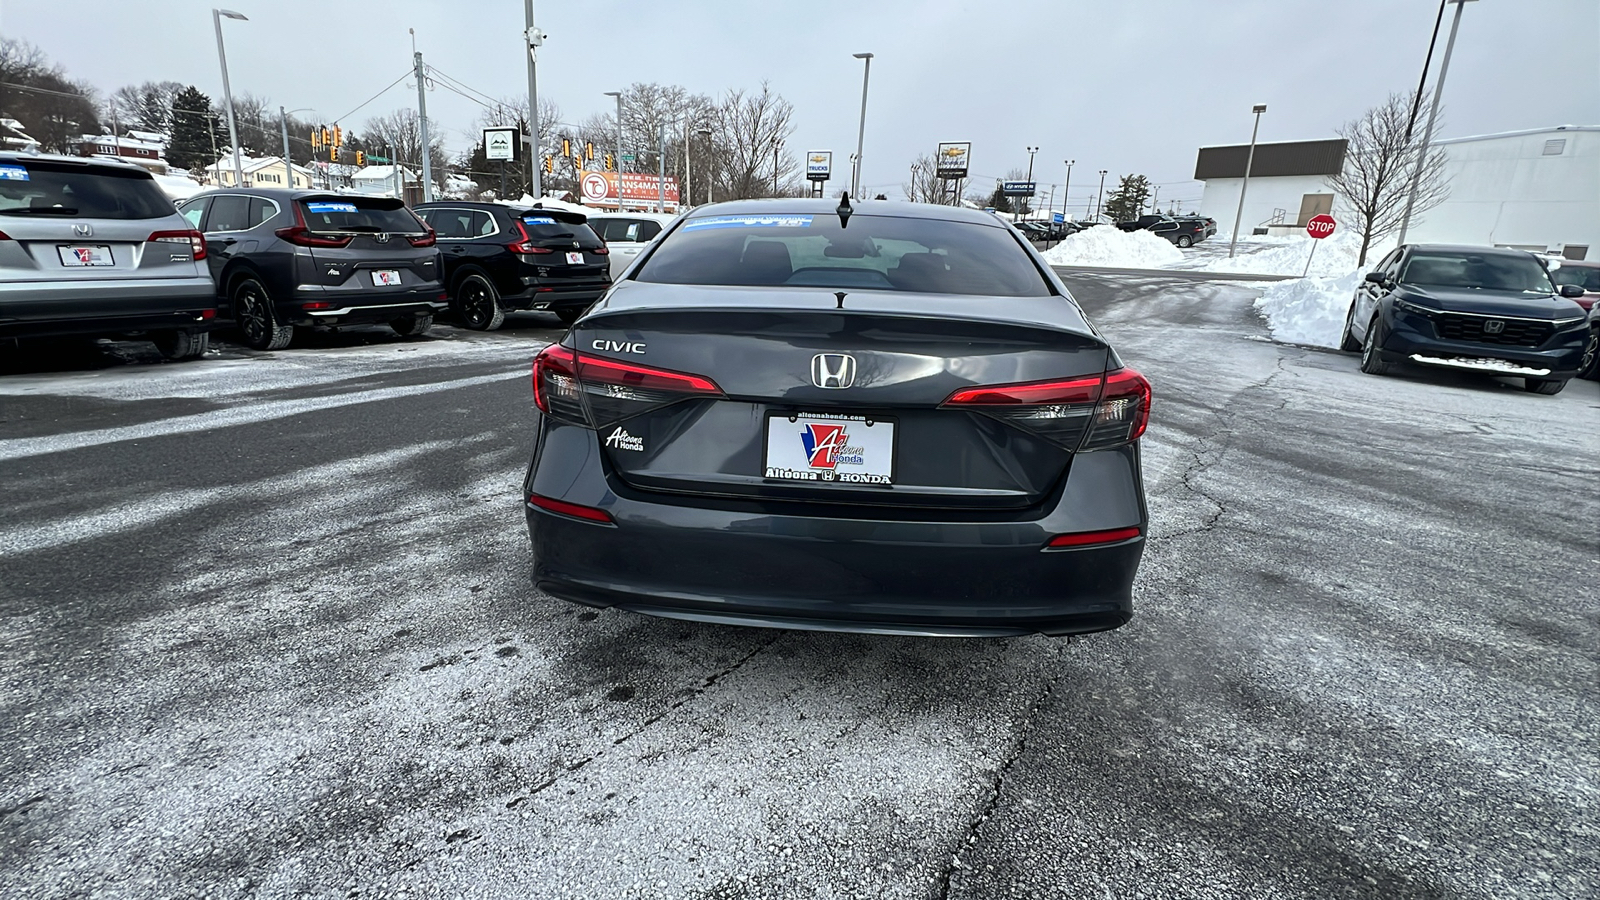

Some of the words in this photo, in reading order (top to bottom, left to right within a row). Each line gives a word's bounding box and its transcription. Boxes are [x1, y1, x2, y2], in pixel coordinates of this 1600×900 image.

[610, 180, 678, 191] TRANS4MATON
[1308, 221, 1334, 232] STOP
[592, 339, 647, 354] CIVIC
[797, 411, 866, 421] altoonahonda.com
[605, 426, 643, 449] Altoona
[620, 441, 644, 452] Honda
[809, 428, 864, 464] Altoona
[831, 453, 864, 465] Honda
[765, 467, 818, 481] Altoona
[839, 472, 892, 485] HONDA
